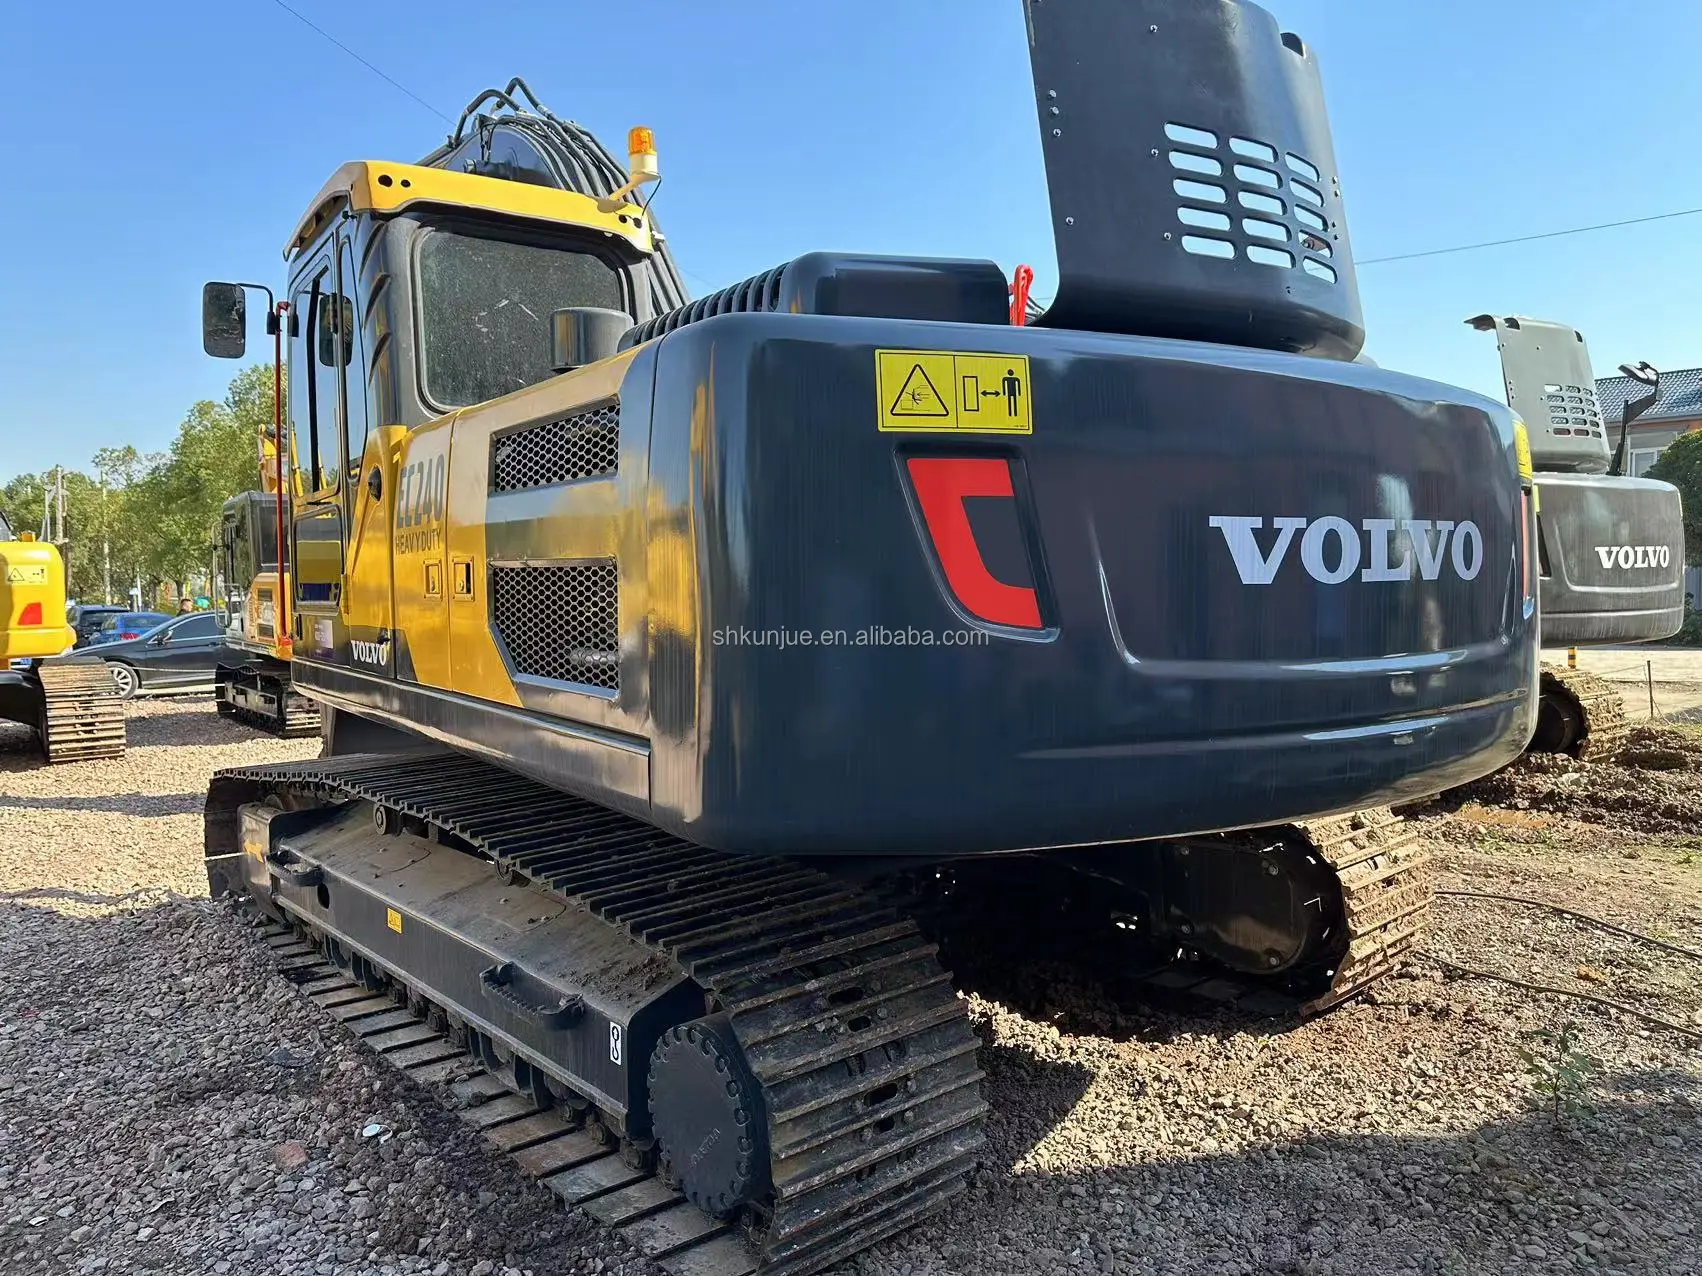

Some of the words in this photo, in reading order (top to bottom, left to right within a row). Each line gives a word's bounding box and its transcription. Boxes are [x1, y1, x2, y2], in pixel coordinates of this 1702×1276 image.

[397, 454, 445, 529] EC240
[1209, 515, 1484, 585] VOLVO
[1594, 545, 1670, 570] VOLVO
[350, 640, 387, 666] VOLVO
